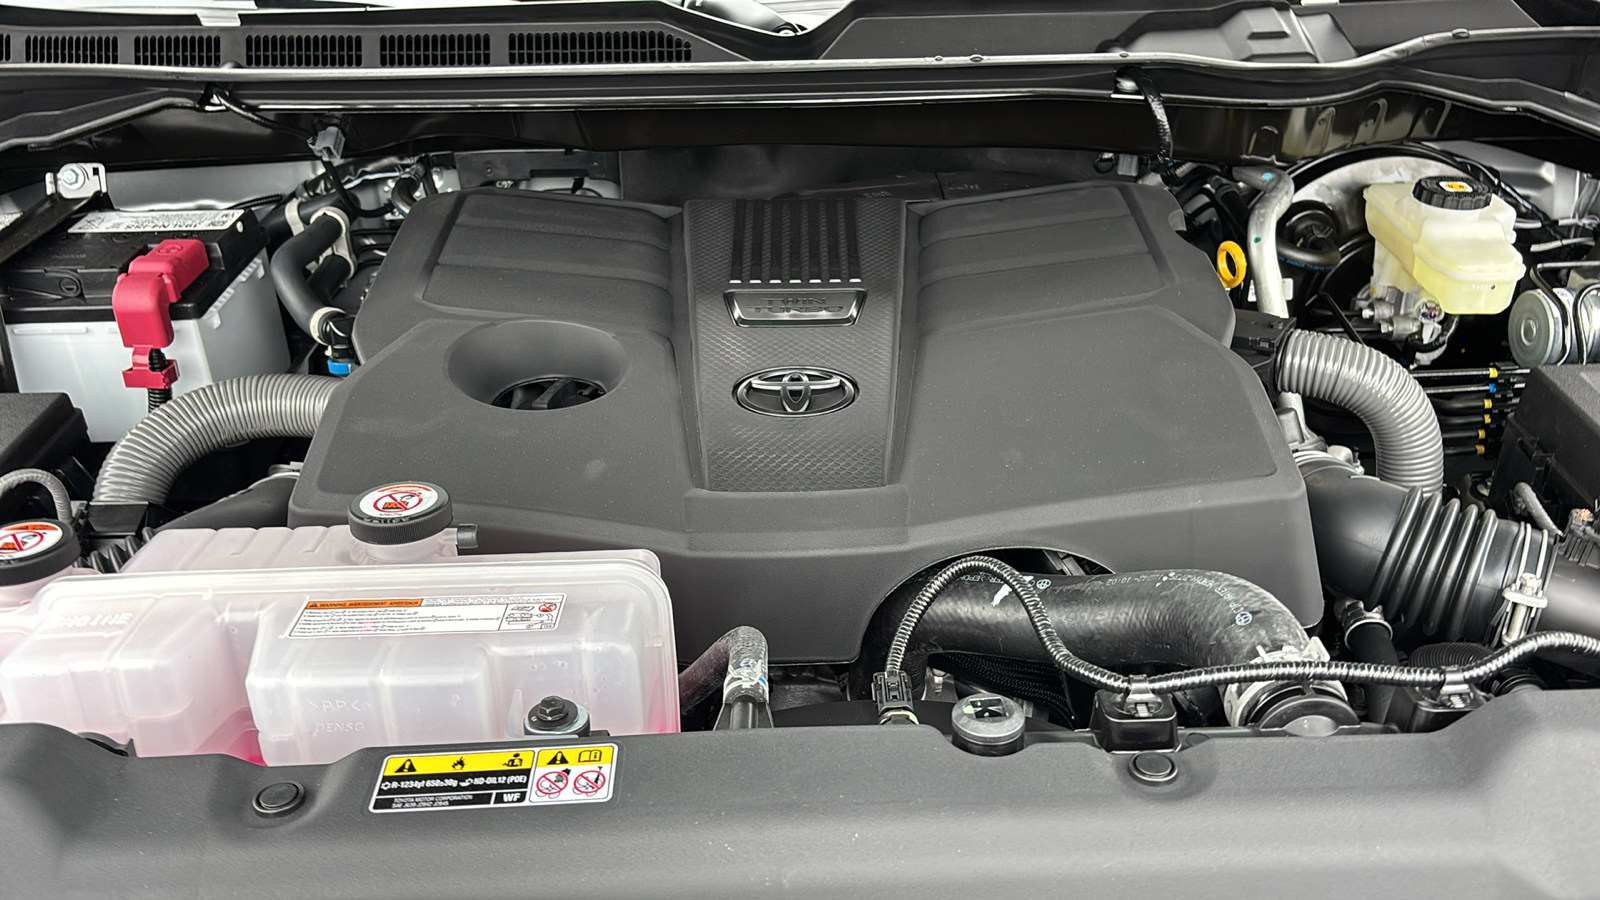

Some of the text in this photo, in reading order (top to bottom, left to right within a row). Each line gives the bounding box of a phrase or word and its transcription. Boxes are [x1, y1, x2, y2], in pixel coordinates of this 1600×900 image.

[761, 297, 827, 305] TWIN
[748, 305, 844, 314] TURBO
[315, 721, 365, 732] DENSO
[507, 775, 528, 785] (POE)
[503, 792, 521, 802] WF
